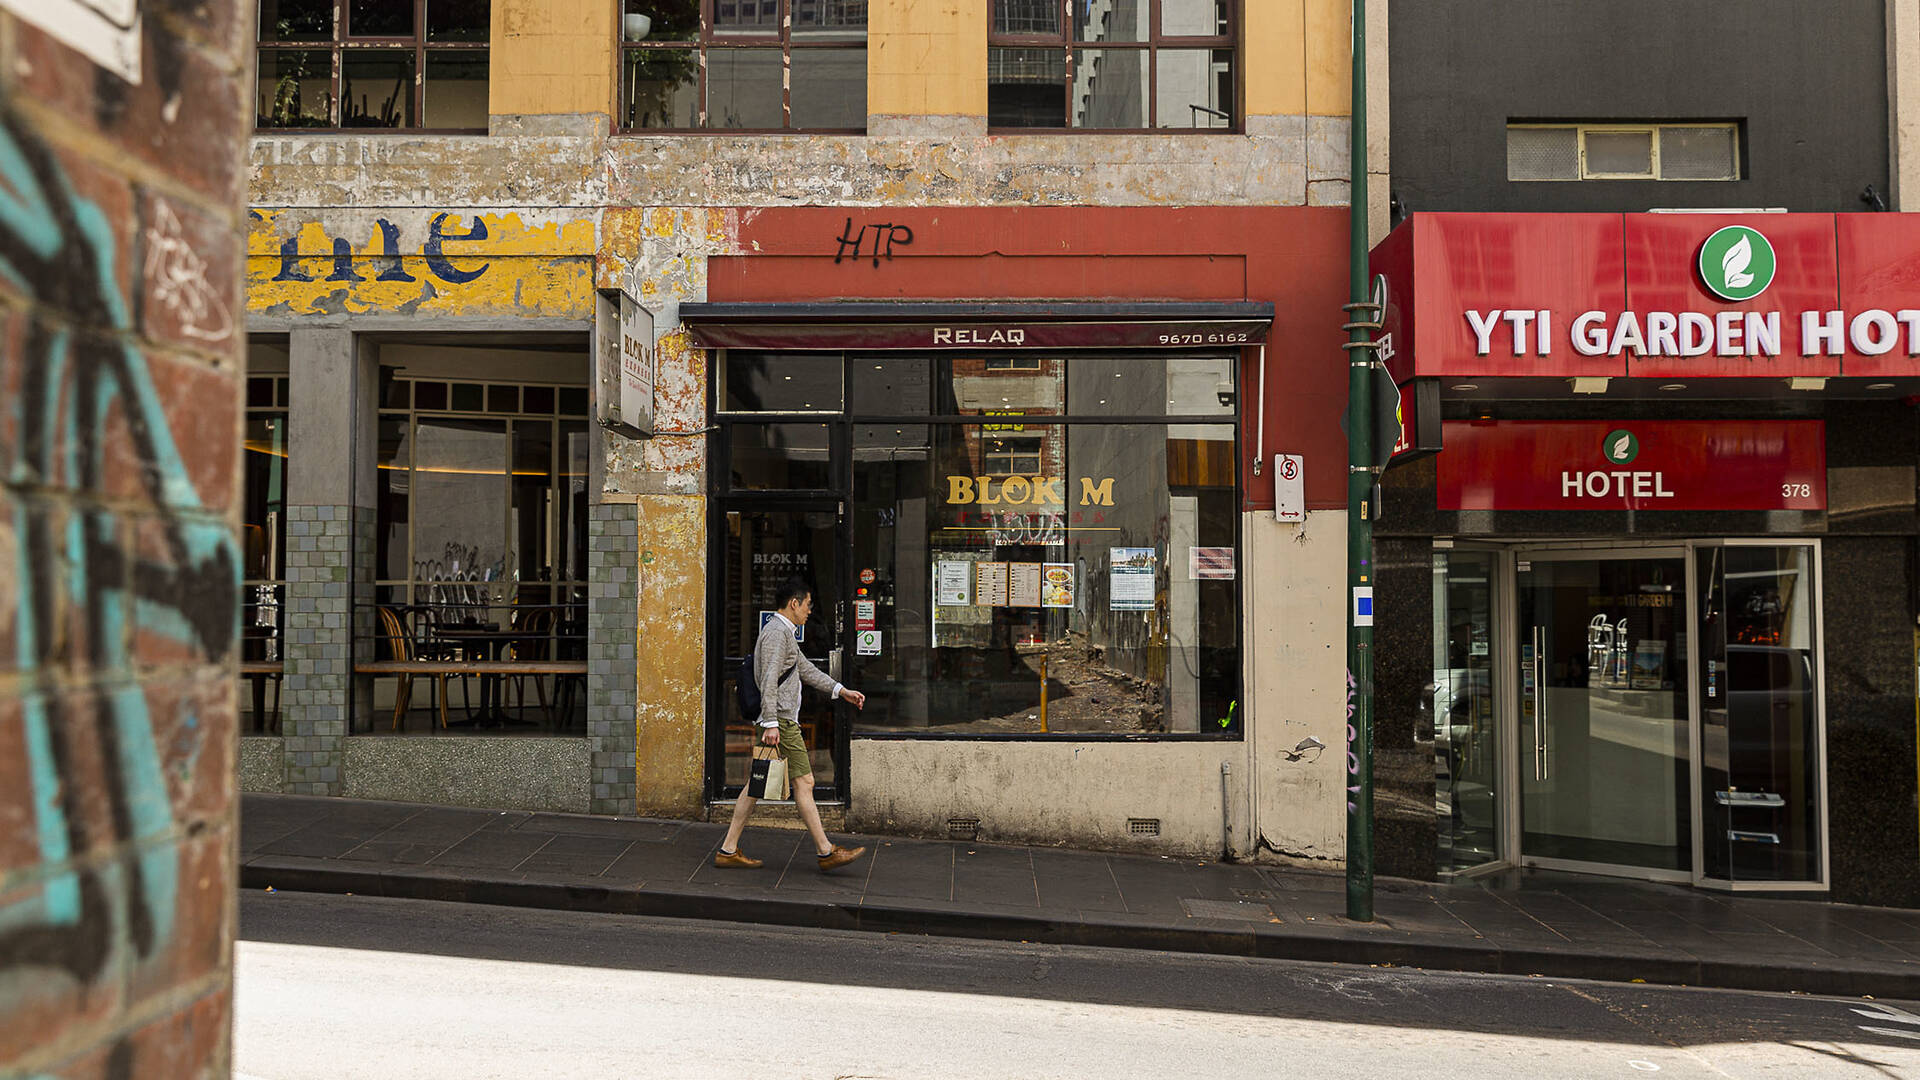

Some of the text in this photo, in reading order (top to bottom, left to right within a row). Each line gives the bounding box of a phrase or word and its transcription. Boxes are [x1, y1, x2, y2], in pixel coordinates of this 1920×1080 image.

[834, 217, 914, 269] HTP
[933, 328, 1025, 346] RELAQ
[1159, 333, 1247, 345] 9670 6162
[1464, 310, 1551, 357] YTI
[1570, 310, 1781, 358] GARDEN
[946, 475, 1116, 507] BLOK M
[1561, 471, 1675, 498] HOTEL
[1781, 484, 1811, 498] 378
[753, 553, 809, 565] BLOK M
